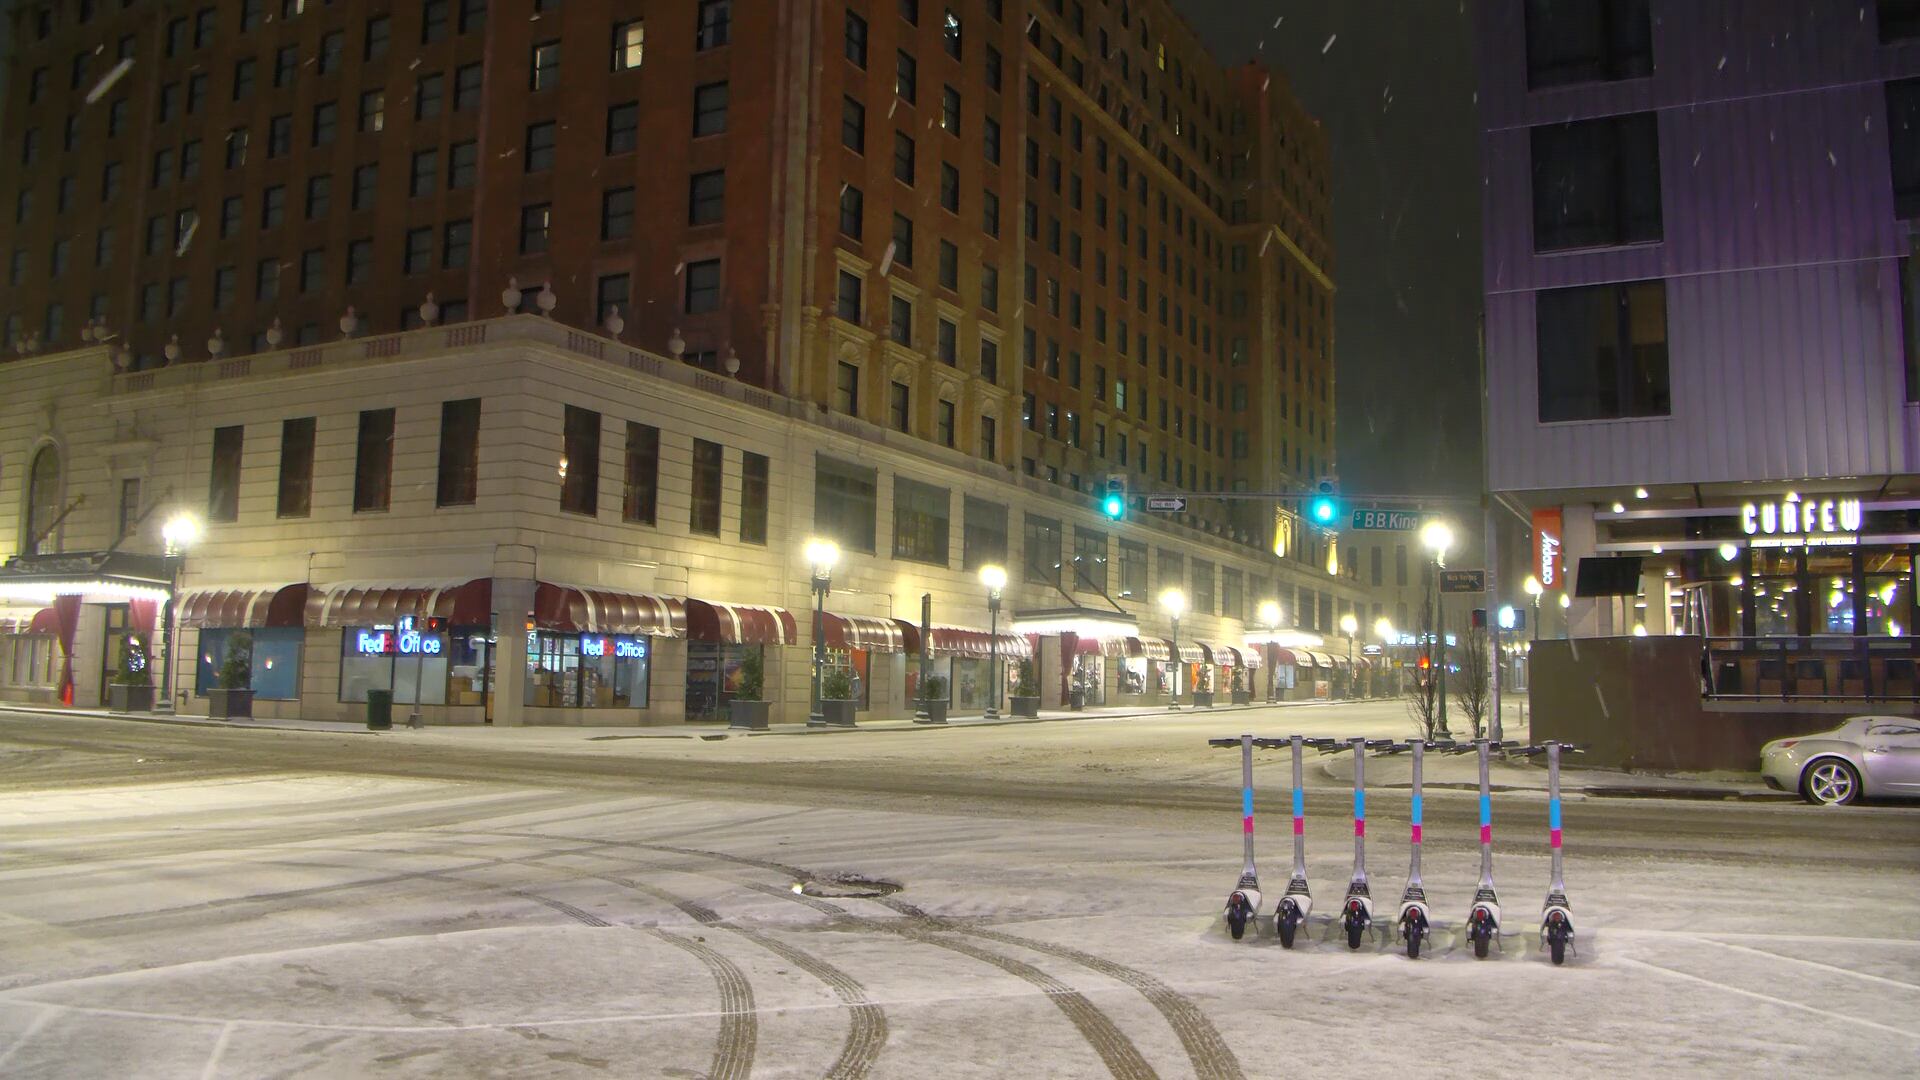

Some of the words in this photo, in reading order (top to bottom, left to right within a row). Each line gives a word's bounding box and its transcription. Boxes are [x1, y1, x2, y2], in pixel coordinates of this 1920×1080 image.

[1355, 512, 1361, 521] S
[1389, 512, 1418, 530] King
[1743, 499, 1860, 534] CURFEW
[1541, 531, 1560, 585] canopy
[583, 638, 615, 656] FedEx
[616, 641, 645, 658] Office
